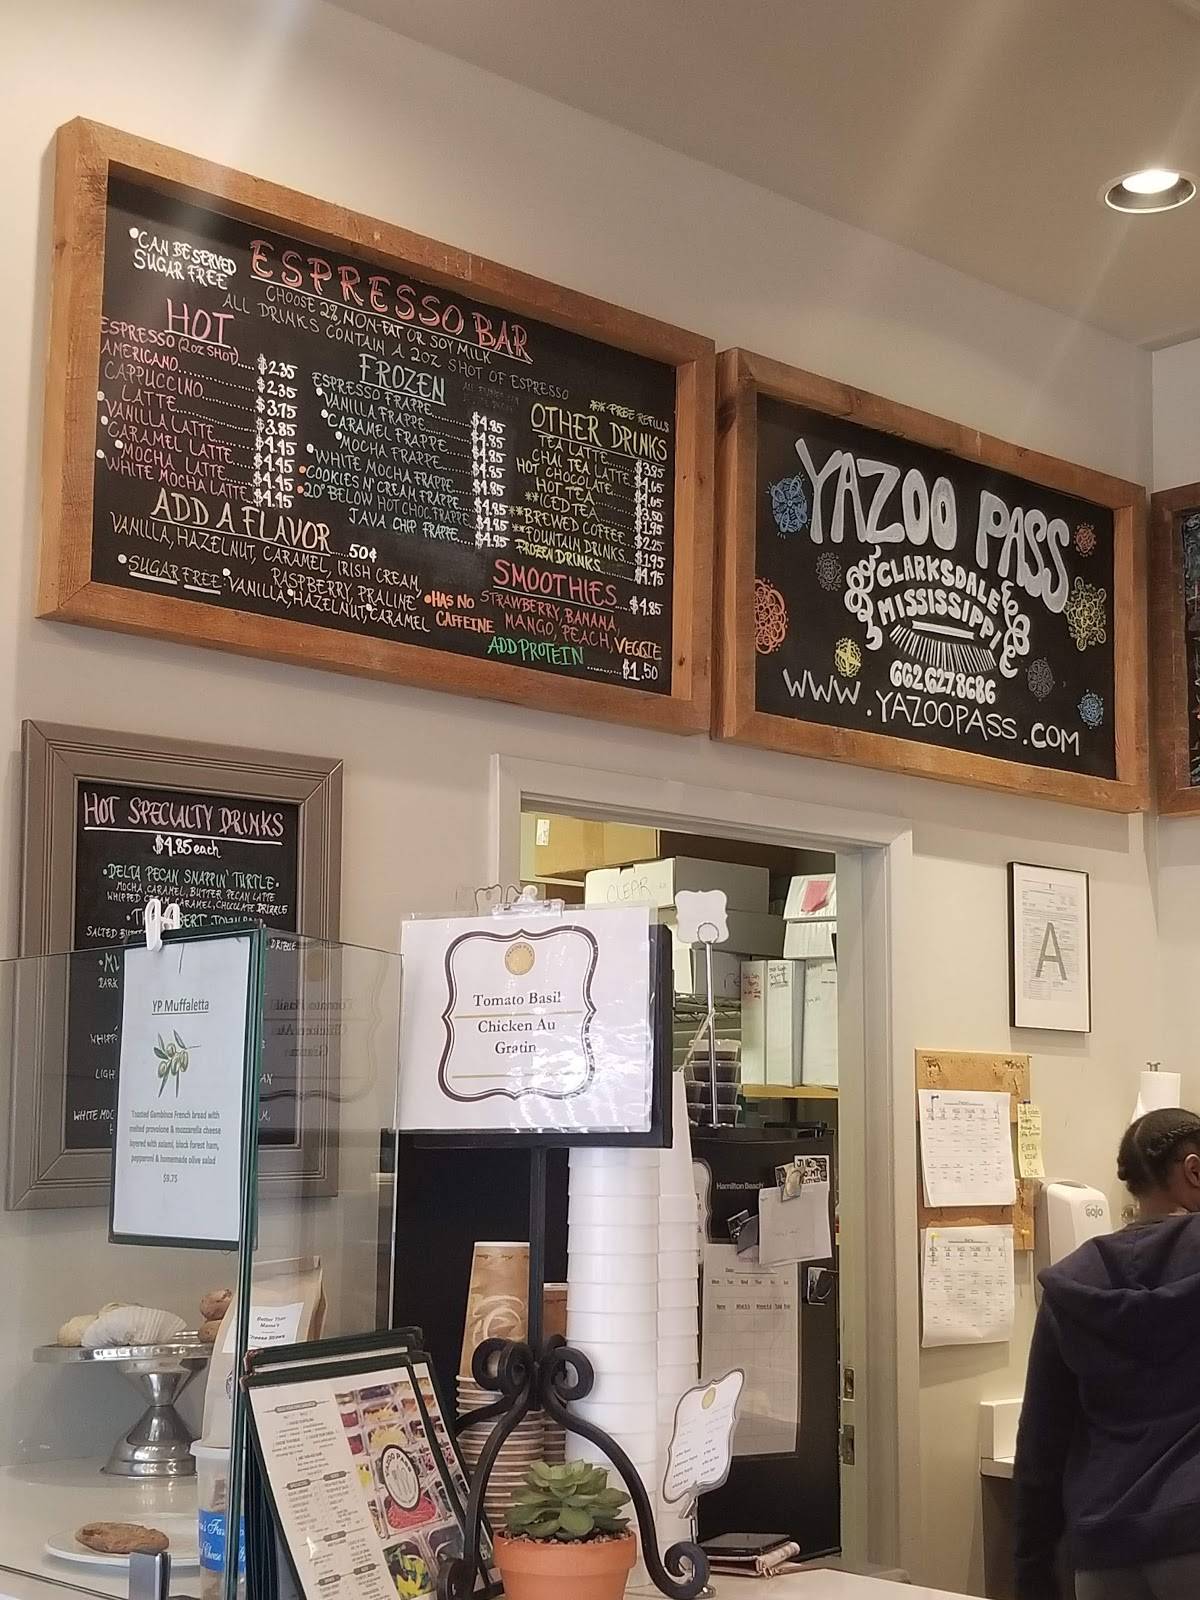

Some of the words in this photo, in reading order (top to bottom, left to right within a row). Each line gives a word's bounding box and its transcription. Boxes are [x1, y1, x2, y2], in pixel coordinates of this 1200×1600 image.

[133, 249, 184, 280] SUGAR
[188, 265, 228, 290] FREE
[138, 230, 169, 256] CAN
[172, 241, 190, 260] BE
[191, 250, 237, 276] SERVED
[250, 239, 464, 335] ESPRESSO
[472, 311, 533, 358] BAR
[100, 316, 175, 348] ESPRESSO
[166, 298, 234, 349] HOT
[266, 285, 316, 313] CHOOSE
[342, 311, 403, 340] NON-FAT
[406, 327, 423, 343] OR
[431, 333, 454, 353] SOY
[457, 341, 492, 365] MILK
[101, 340, 178, 371] AMERICANO
[221, 293, 250, 314] ALL
[258, 302, 320, 333] DRINKS
[325, 324, 385, 356] CONTAIN
[391, 344, 405, 358] A
[448, 358, 483, 381] SHOT
[489, 370, 506, 385] OF
[509, 374, 569, 401] ESPRESSO
[104, 361, 204, 398] CAPPUCCINO
[256, 395, 298, 419] $3.75
[358, 353, 444, 403] FROZEN
[121, 385, 177, 413] LATTE
[256, 417, 297, 436] $3.85
[312, 372, 380, 399] ESPRESSO
[384, 391, 432, 415] FRAPPE
[471, 411, 506, 433] $4.85
[323, 391, 377, 420] VANILLA
[378, 406, 426, 431] FRAPPE
[105, 399, 169, 430] VANILLA
[172, 412, 217, 442] LATTE
[255, 433, 297, 456] $4.45
[106, 421, 182, 453] CARAMEL
[190, 438, 234, 464] LATTE
[254, 452, 295, 474] $4.45
[327, 413, 392, 441] CARAMEL
[395, 428, 448, 453] FRAPPE
[531, 403, 602, 448] OTHER
[609, 422, 668, 461] DRINKS
[122, 442, 175, 470] MOCHA
[186, 456, 227, 482] LATTE
[253, 471, 294, 491] $4.45
[340, 435, 388, 459] MOCHA
[391, 447, 443, 470] FRAPPE
[532, 449, 563, 467] CHAI
[567, 458, 591, 476] TEA
[594, 464, 631, 486] LATTE
[538, 435, 563, 452] TEA
[569, 442, 609, 465] LATTE
[104, 455, 154, 480] WHITE
[159, 467, 204, 493] MOCHA
[210, 482, 248, 502] LATTE
[253, 488, 294, 509] $4.45
[306, 465, 359, 488] COOKIES
[377, 481, 416, 499] CREAM
[419, 490, 460, 510] FRAPPE
[314, 449, 362, 471] WHITE
[365, 459, 412, 484] MOCHA
[414, 471, 454, 492] FRAPPE
[516, 456, 540, 476] HOT
[545, 466, 613, 496] CHOCOLATE
[536, 476, 563, 497] HOT
[565, 486, 595, 505] TEA
[150, 487, 210, 526] ADD
[216, 502, 236, 534] A
[241, 506, 331, 554] FLAVOR
[327, 485, 373, 506] BELOW
[378, 496, 400, 512] HOT
[432, 507, 471, 527] FRAPPE
[349, 507, 386, 528] JAVA
[392, 517, 417, 533] CHIP
[422, 522, 458, 541] FRAPPE
[571, 502, 600, 523] TEA
[794, 438, 958, 551] YAZOO
[975, 489, 1070, 614] PASS
[582, 522, 626, 545] COFFEE
[584, 539, 625, 562] DRINKS
[337, 560, 371, 580] IRISH
[514, 538, 554, 564] FROZEN
[554, 549, 601, 573] DRINKS
[128, 554, 180, 581] SUGAR
[369, 608, 430, 632] CARAMEL
[357, 585, 416, 611] PRALINE
[431, 590, 454, 609] HAS
[493, 558, 617, 607] SMOOTHIES
[876, 555, 1000, 616] CLARKSDALE
[436, 610, 496, 634] CAFFEINE
[877, 588, 1002, 650] MISSISSIPPI
[488, 636, 517, 656] ADD
[518, 639, 584, 666] PROTEIN
[614, 636, 663, 661] VEGGIE
[889, 660, 996, 704] 662.627.8686
[84, 792, 120, 826] HOT
[127, 796, 214, 832] SPECIALTY
[218, 807, 284, 838] DRINKS
[153, 835, 192, 857] $4.85
[193, 840, 221, 859] each
[108, 863, 141, 881] DELTA
[145, 866, 179, 886] PECAN
[232, 871, 275, 890] TURTLE
[191, 887, 222, 900] BUTTER
[227, 889, 250, 901] PECAN
[253, 892, 275, 902] LATTE
[107, 891, 141, 903] WHIPPED
[1036, 921, 1068, 980] A
[152, 1000, 163, 1012] YP
[164, 998, 209, 1012] Muffaletta
[473, 993, 525, 1008] Tomato
[529, 991, 561, 1005] Basil
[477, 1020, 533, 1033] Chicken
[537, 1019, 556, 1031] Au
[494, 1041, 536, 1055] Gratin
[716, 1182, 744, 1190] Hamilton
